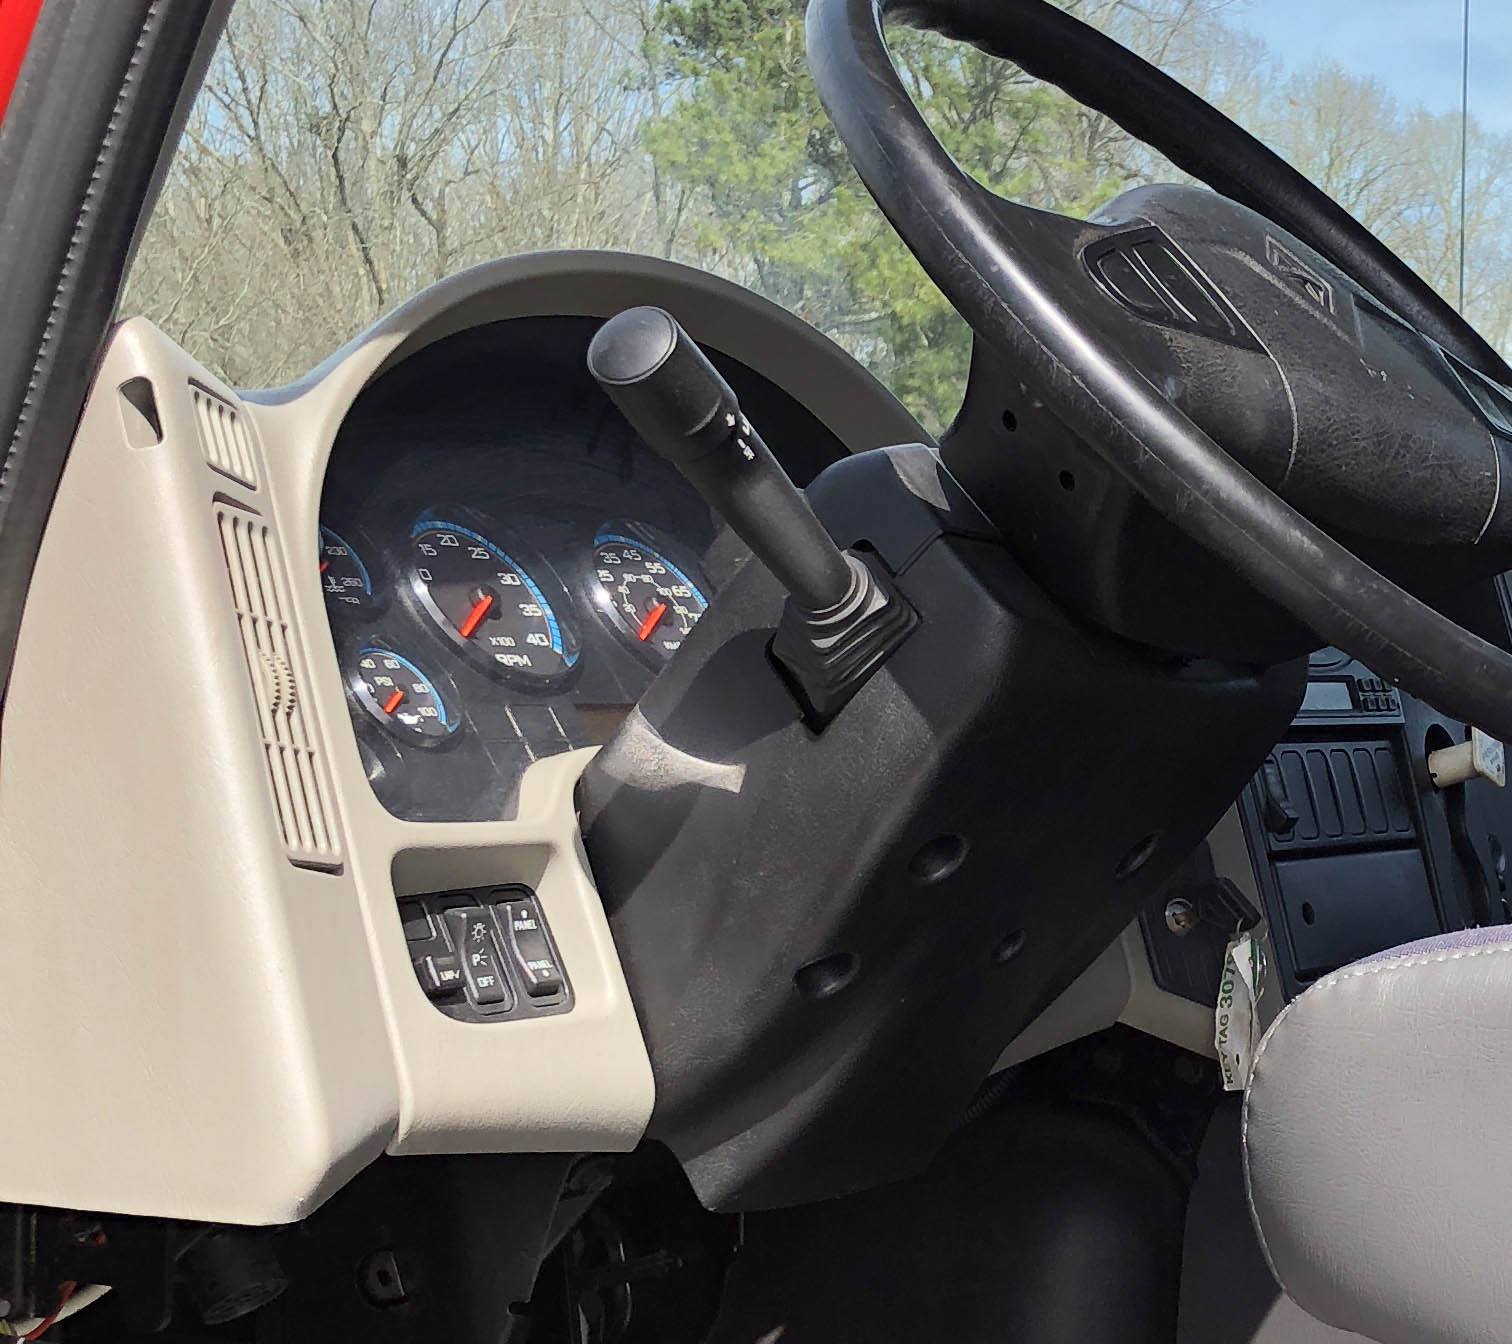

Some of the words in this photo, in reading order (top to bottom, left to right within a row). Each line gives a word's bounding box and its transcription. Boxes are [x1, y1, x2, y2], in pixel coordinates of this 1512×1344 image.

[436, 534, 460, 547] 20
[418, 543, 438, 556] 15
[467, 546, 490, 560] 25
[622, 549, 642, 561] 45
[600, 551, 622, 564] 35
[644, 561, 666, 574] 55
[496, 573, 522, 586] 30
[671, 585, 693, 598] 65
[518, 604, 543, 617] 35
[526, 633, 550, 646] 40
[383, 659, 401, 670] 60
[494, 653, 533, 667] RPM
[373, 676, 394, 687] PSI
[411, 683, 430, 694] 80
[416, 706, 438, 717] 100
[514, 919, 538, 932] PANEL
[527, 959, 554, 971] PANEL
[476, 975, 495, 988] OFF
[1217, 1013, 1230, 1046] TAG
